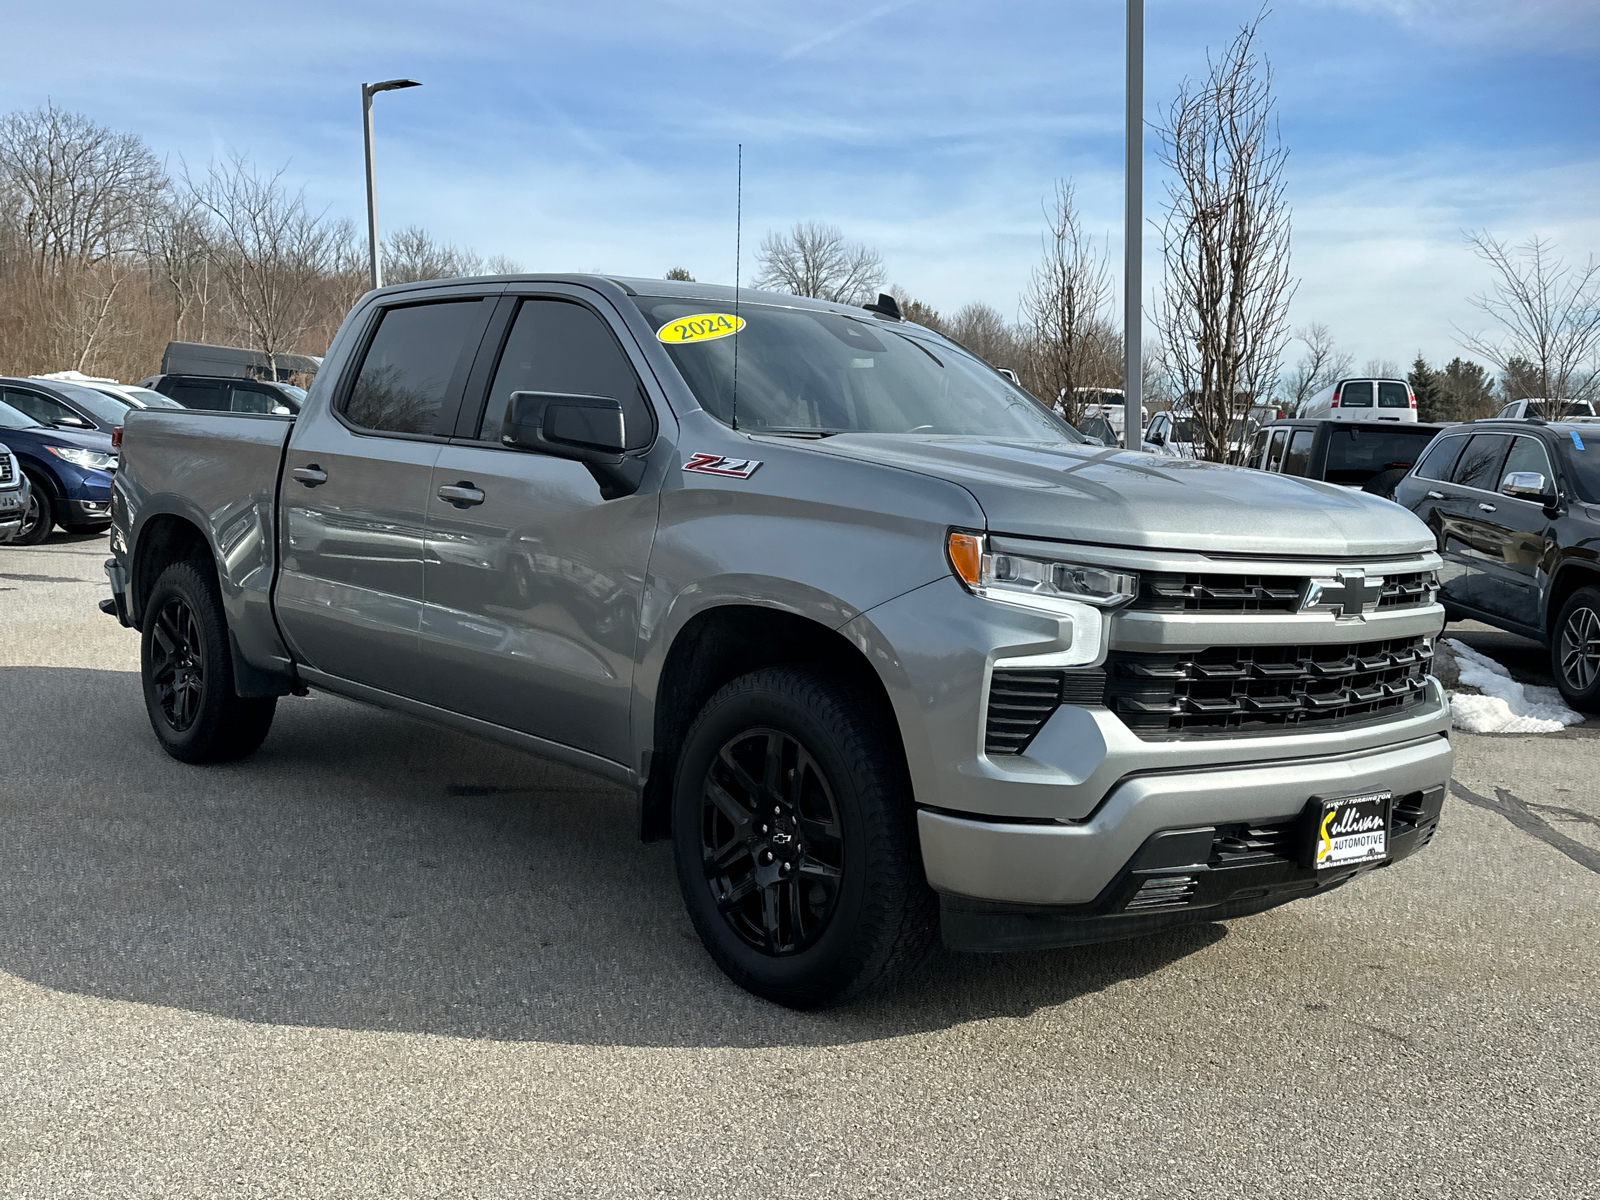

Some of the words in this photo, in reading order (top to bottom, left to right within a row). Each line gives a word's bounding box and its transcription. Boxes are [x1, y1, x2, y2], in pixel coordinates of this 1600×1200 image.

[674, 315, 733, 340] 2024
[681, 452, 763, 479] Z71
[1317, 807, 1384, 860] Sullivan
[1333, 834, 1383, 851] AUTOMOTIVE
